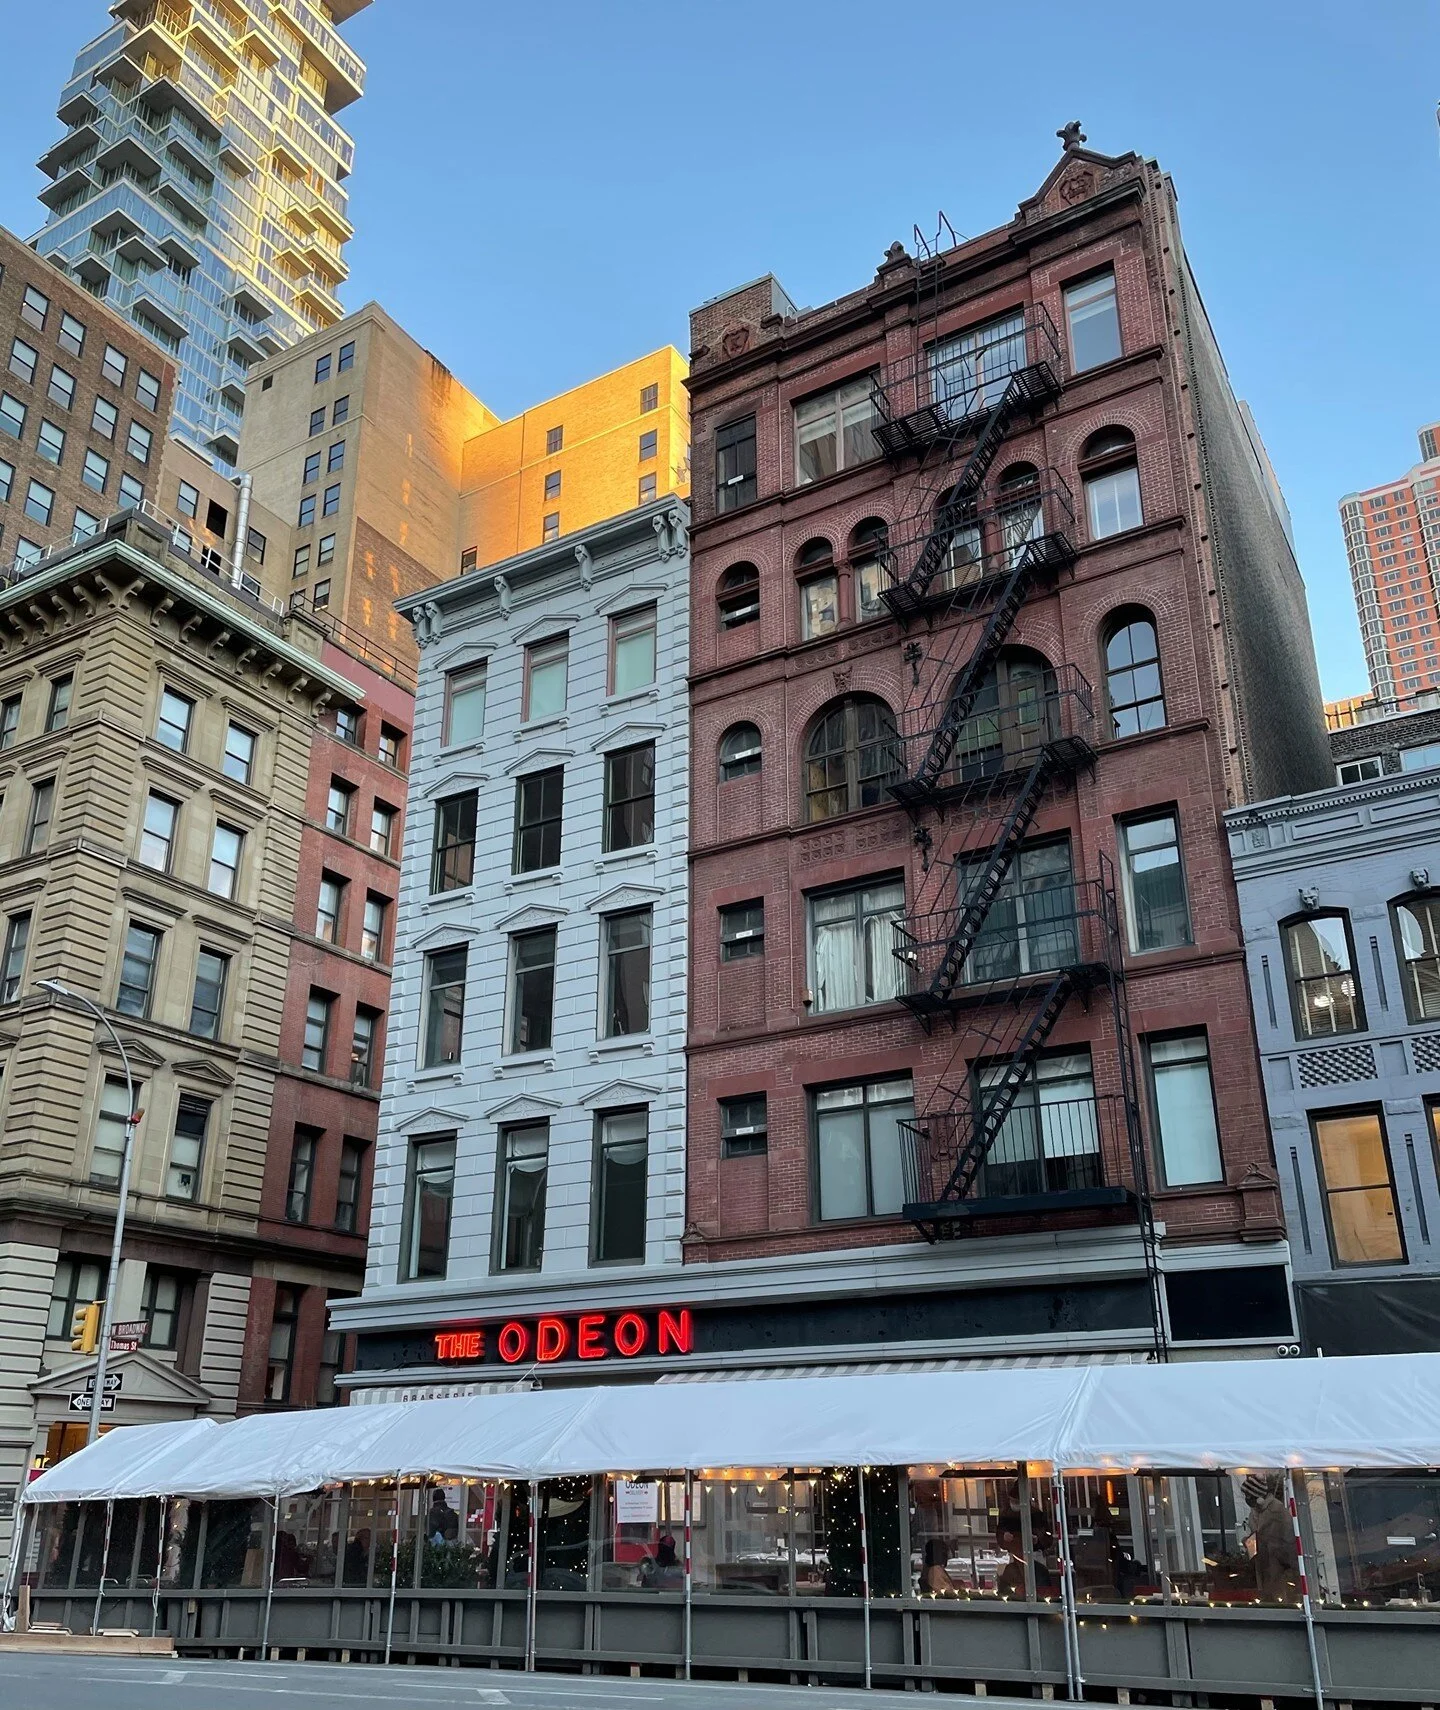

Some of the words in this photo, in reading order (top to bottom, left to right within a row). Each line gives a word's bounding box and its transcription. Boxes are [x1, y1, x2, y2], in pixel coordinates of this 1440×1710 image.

[118, 1322, 147, 1335] BROADWAY
[435, 1333, 482, 1359] THE
[498, 1309, 694, 1363] ODEON
[110, 1340, 130, 1350] Thomas
[130, 1341, 137, 1351] St
[106, 1378, 118, 1387] WAY
[76, 1398, 90, 1406] ONE
